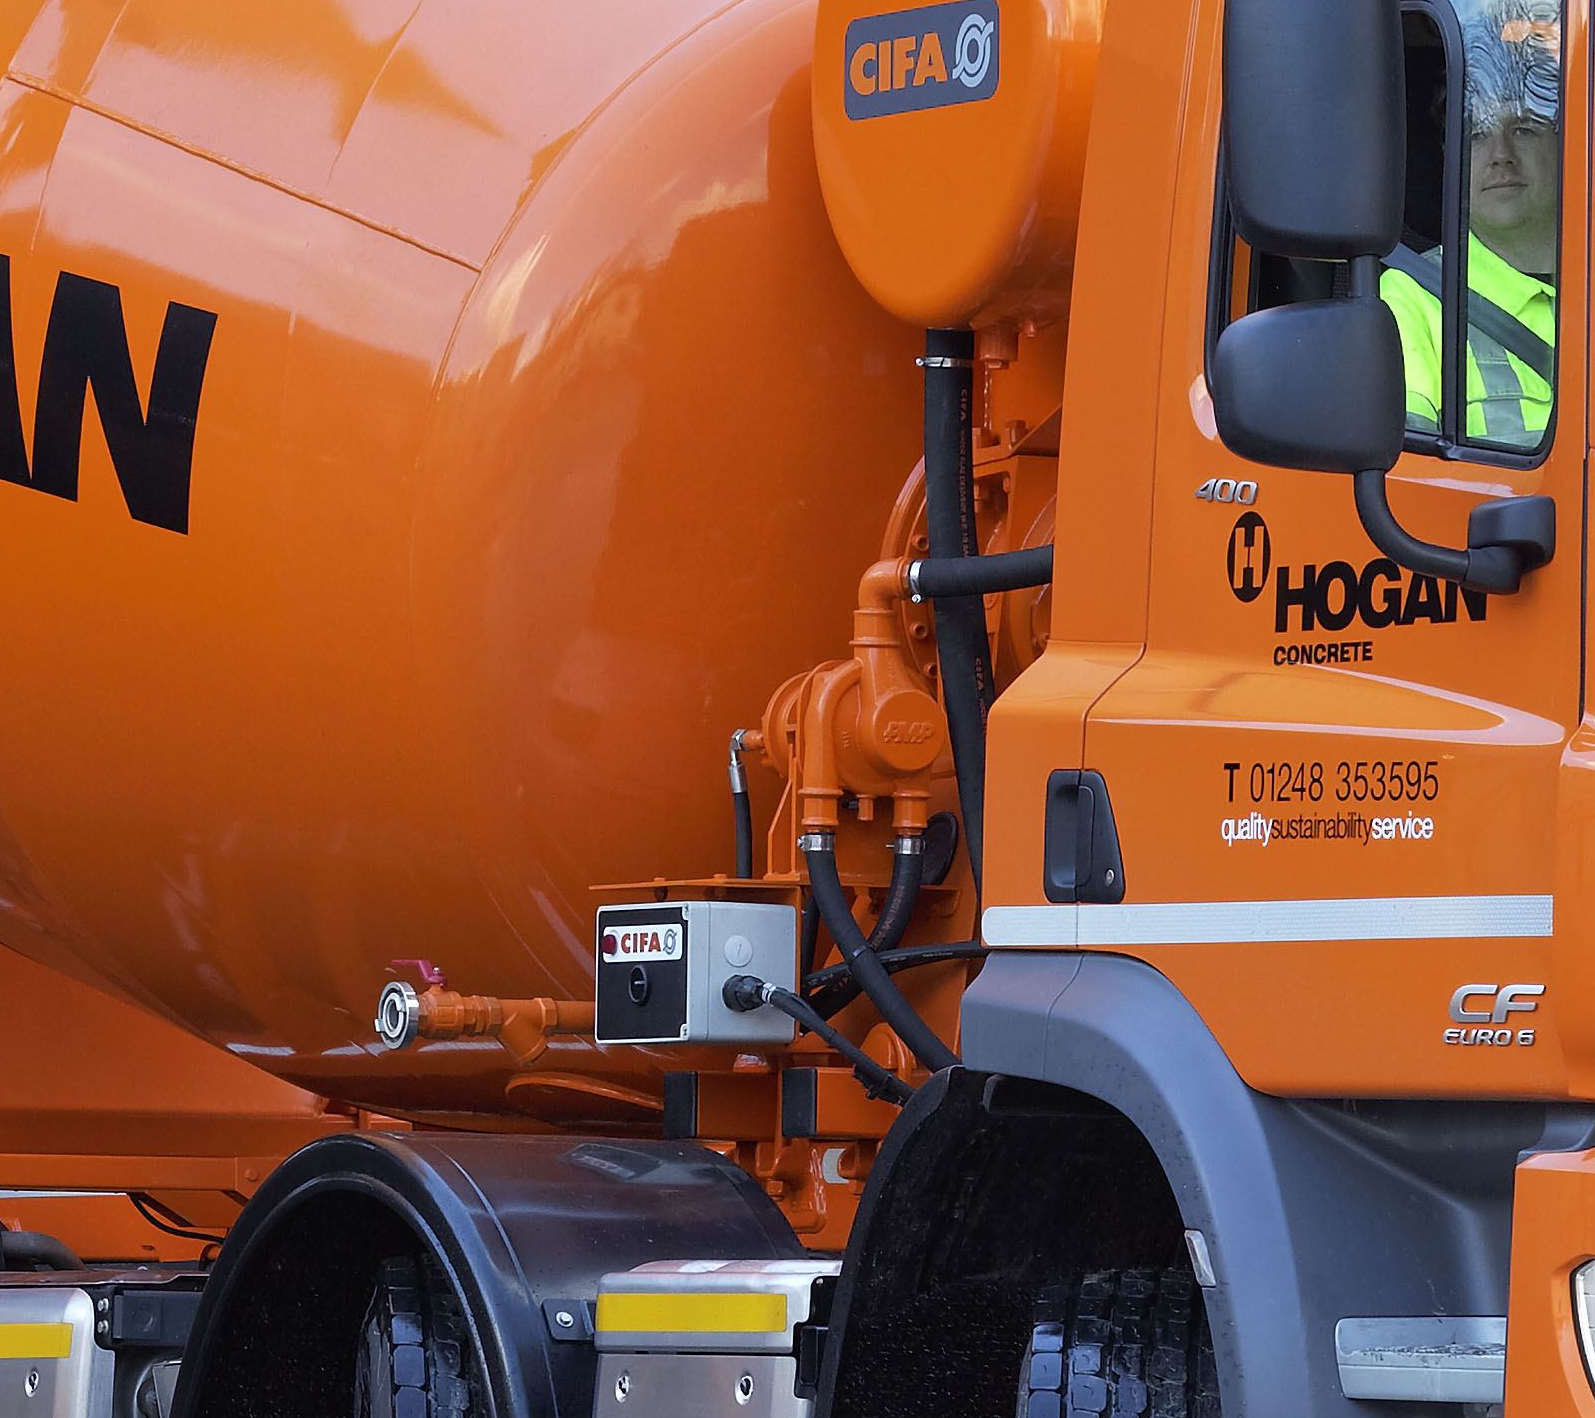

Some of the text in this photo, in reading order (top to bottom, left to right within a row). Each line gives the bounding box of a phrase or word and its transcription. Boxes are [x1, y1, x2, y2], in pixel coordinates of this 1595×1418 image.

[849, 32, 948, 96] CIFA
[1194, 478, 1259, 505] 400
[1274, 558, 1488, 633] HOGAN
[1273, 641, 1374, 666] CONCRETE
[1223, 760, 1439, 803] T 01248 353595
[620, 931, 662, 954] CIFA
[1448, 983, 1546, 1024] CF
[1442, 1028, 1536, 1046] EURO 6
